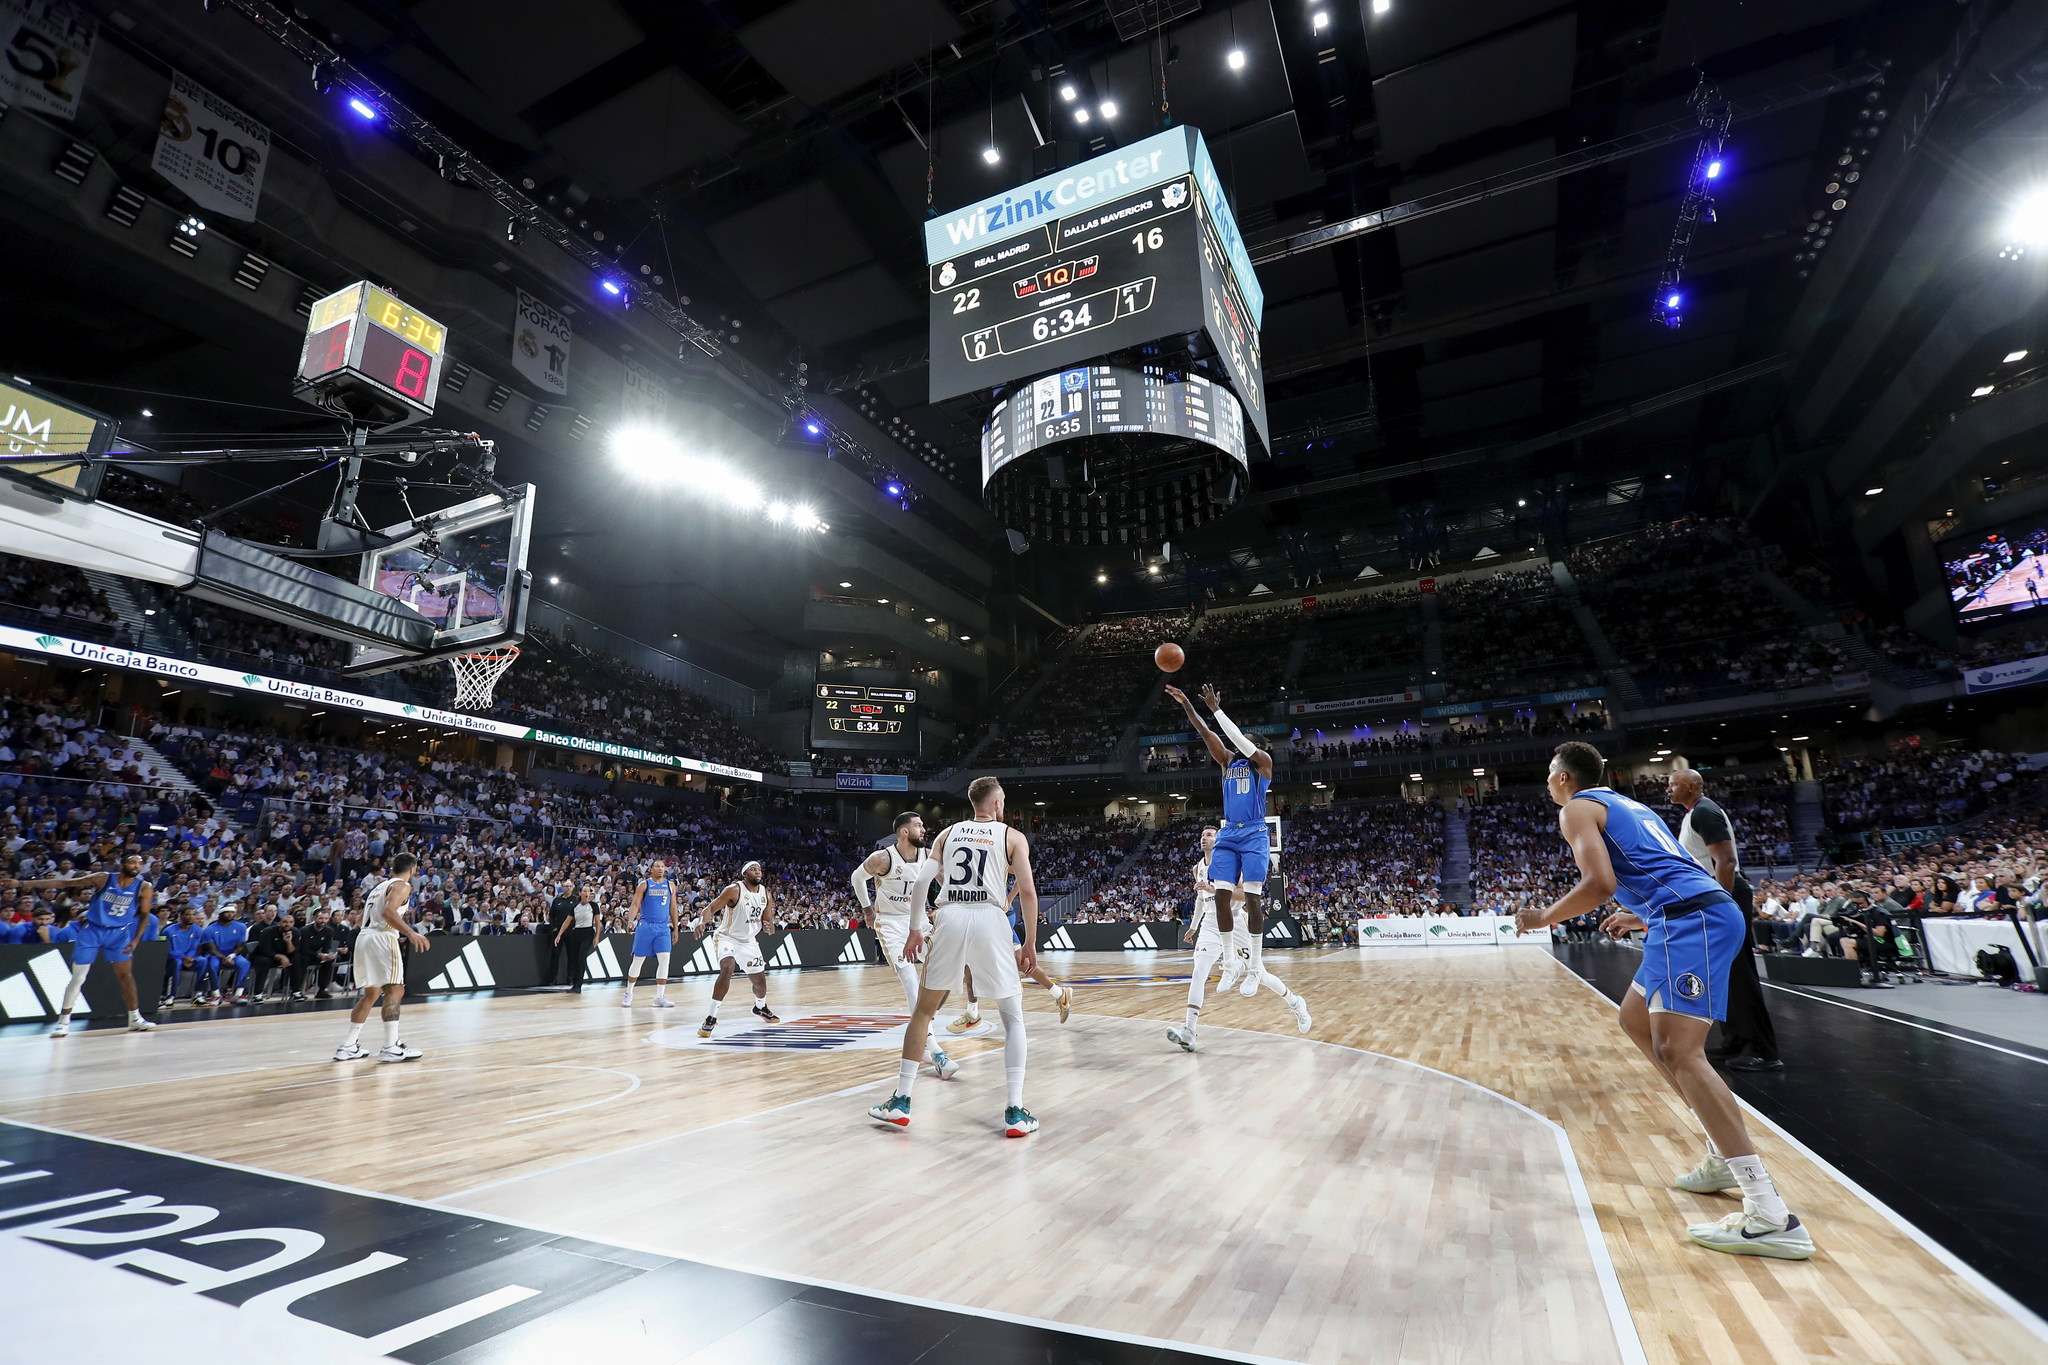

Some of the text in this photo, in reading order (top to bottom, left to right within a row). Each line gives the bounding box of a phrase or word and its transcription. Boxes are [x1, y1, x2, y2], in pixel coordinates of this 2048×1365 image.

[6, 25, 57, 80] 5
[174, 82, 198, 103] DE
[197, 126, 245, 175] 10
[1064, 200, 1153, 238] DALLAS MAVERICKS
[1132, 228, 1164, 254] 16
[974, 243, 1030, 268] REAL MADRID
[1043, 268, 1069, 288] 1Q
[1123, 283, 1143, 297] FT
[952, 288, 980, 314] 22
[1124, 294, 1136, 312] 1
[520, 292, 570, 332] COPA
[1032, 303, 1092, 341] 6:34
[382, 302, 442, 350] 6:34
[520, 304, 570, 342] KORAC
[974, 330, 992, 342] FT
[974, 342, 986, 358] 0
[396, 348, 429, 397] 8
[544, 371, 564, 390] 1988
[625, 358, 666, 391] COPA
[626, 370, 666, 406] ULEB
[1040, 399, 1054, 420] 22
[1045, 418, 1080, 438] 6:35
[70, 642, 198, 677] Unicaja Banco
[268, 679, 364, 708] Unicaja Banco
[1315, 700, 1355, 710] Comunidad
[1368, 696, 1394, 704] Madrid
[826, 701, 838, 709] 22
[894, 704, 905, 713] 16
[422, 709, 496, 732] Unicaja Banco
[856, 722, 879, 732] 6:34
[535, 730, 673, 766] Banco Oficial del Real Madrid
[710, 764, 752, 778] Unicaja Banco
[1236, 778, 1250, 794] 10
[952, 837, 994, 846] AUTOHERO
[960, 827, 993, 836] MUSA
[949, 847, 988, 886] 31
[661, 896, 668, 905] 3
[948, 890, 988, 902] MADRID
[108, 904, 129, 917] 55
[750, 906, 762, 917] 28
